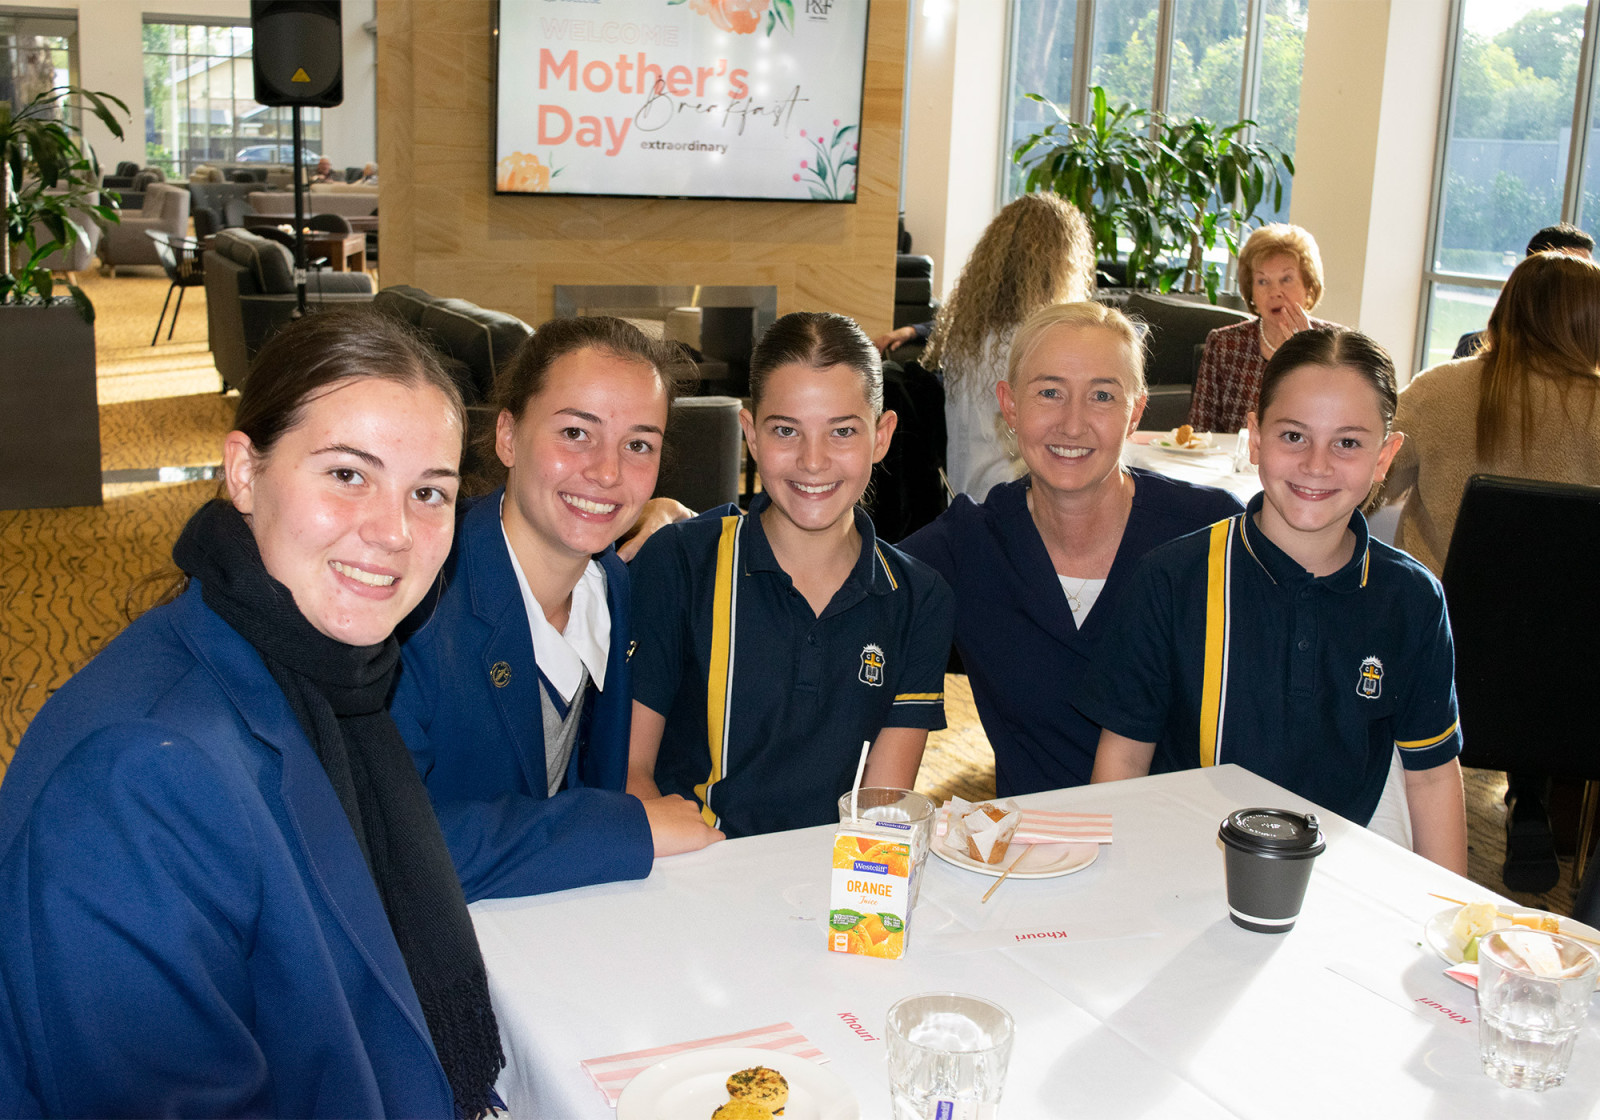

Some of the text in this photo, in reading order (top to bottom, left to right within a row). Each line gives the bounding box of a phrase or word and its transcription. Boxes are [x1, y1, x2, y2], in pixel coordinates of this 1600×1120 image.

[540, 16, 679, 47] WELCOME
[538, 48, 749, 100] Mother's
[635, 75, 809, 139] Breakfast
[537, 104, 632, 156] Day
[640, 140, 728, 155] extraordinary
[855, 862, 887, 873] Westcliff
[847, 879, 893, 897] ORANGE
[858, 895, 879, 905] Juice
[1015, 930, 1068, 942] Khouri
[1414, 997, 1472, 1024] Khouri
[836, 1012, 880, 1041] Khouri
